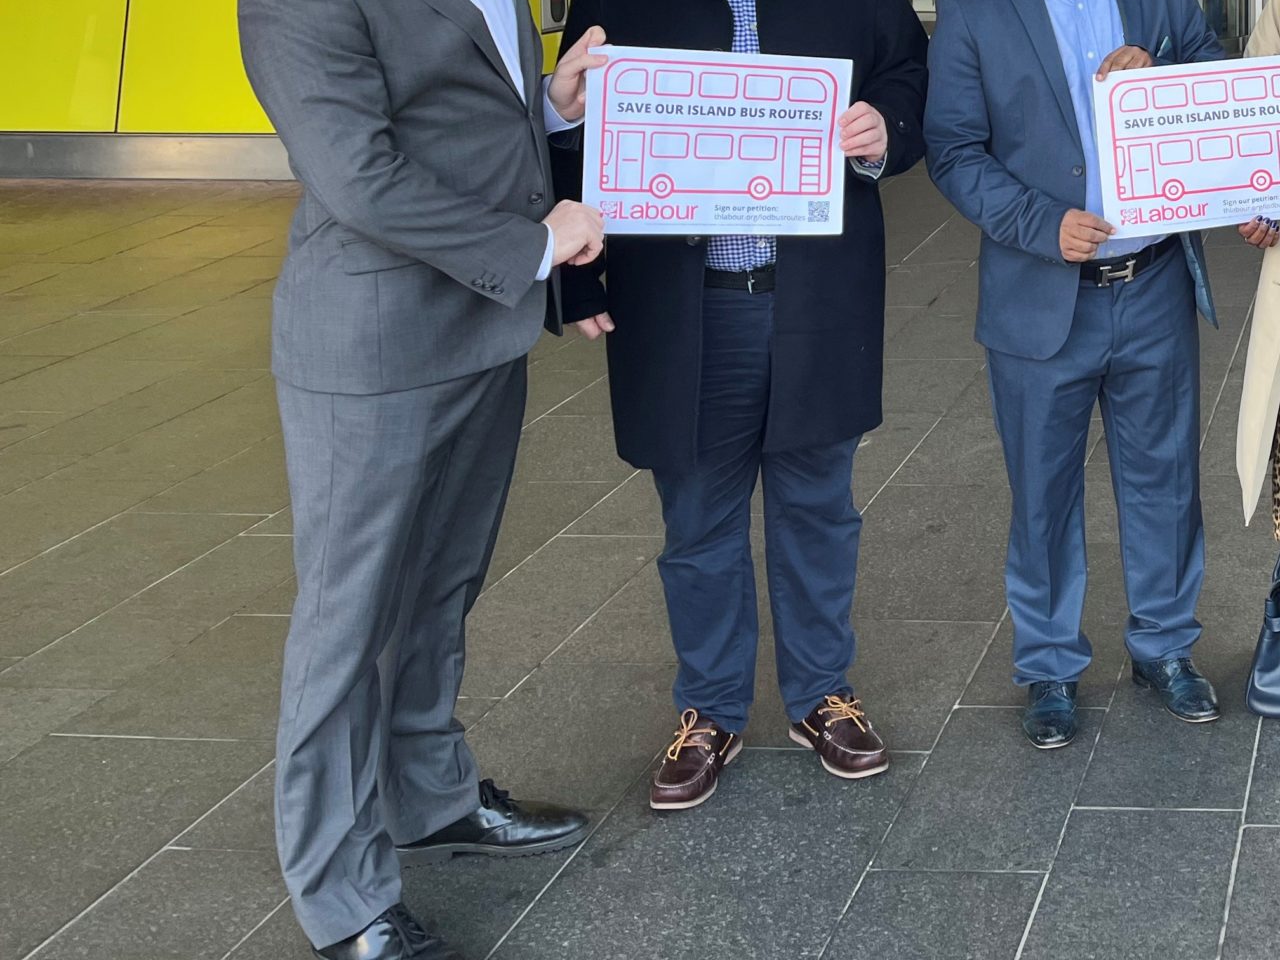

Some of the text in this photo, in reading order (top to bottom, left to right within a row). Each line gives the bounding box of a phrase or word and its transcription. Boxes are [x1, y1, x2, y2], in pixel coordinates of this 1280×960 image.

[617, 102, 823, 121] SAVE OUR ISLAND BUS ROUTES!
[1124, 116, 1155, 129] SAVE
[1157, 113, 1184, 126] OUR
[1186, 110, 1230, 123] ISLAND
[1233, 106, 1257, 119] BUS
[618, 200, 699, 220] Labour
[714, 204, 731, 213] Sign
[1222, 199, 1238, 207] Sign
[1139, 202, 1209, 225] Labour
